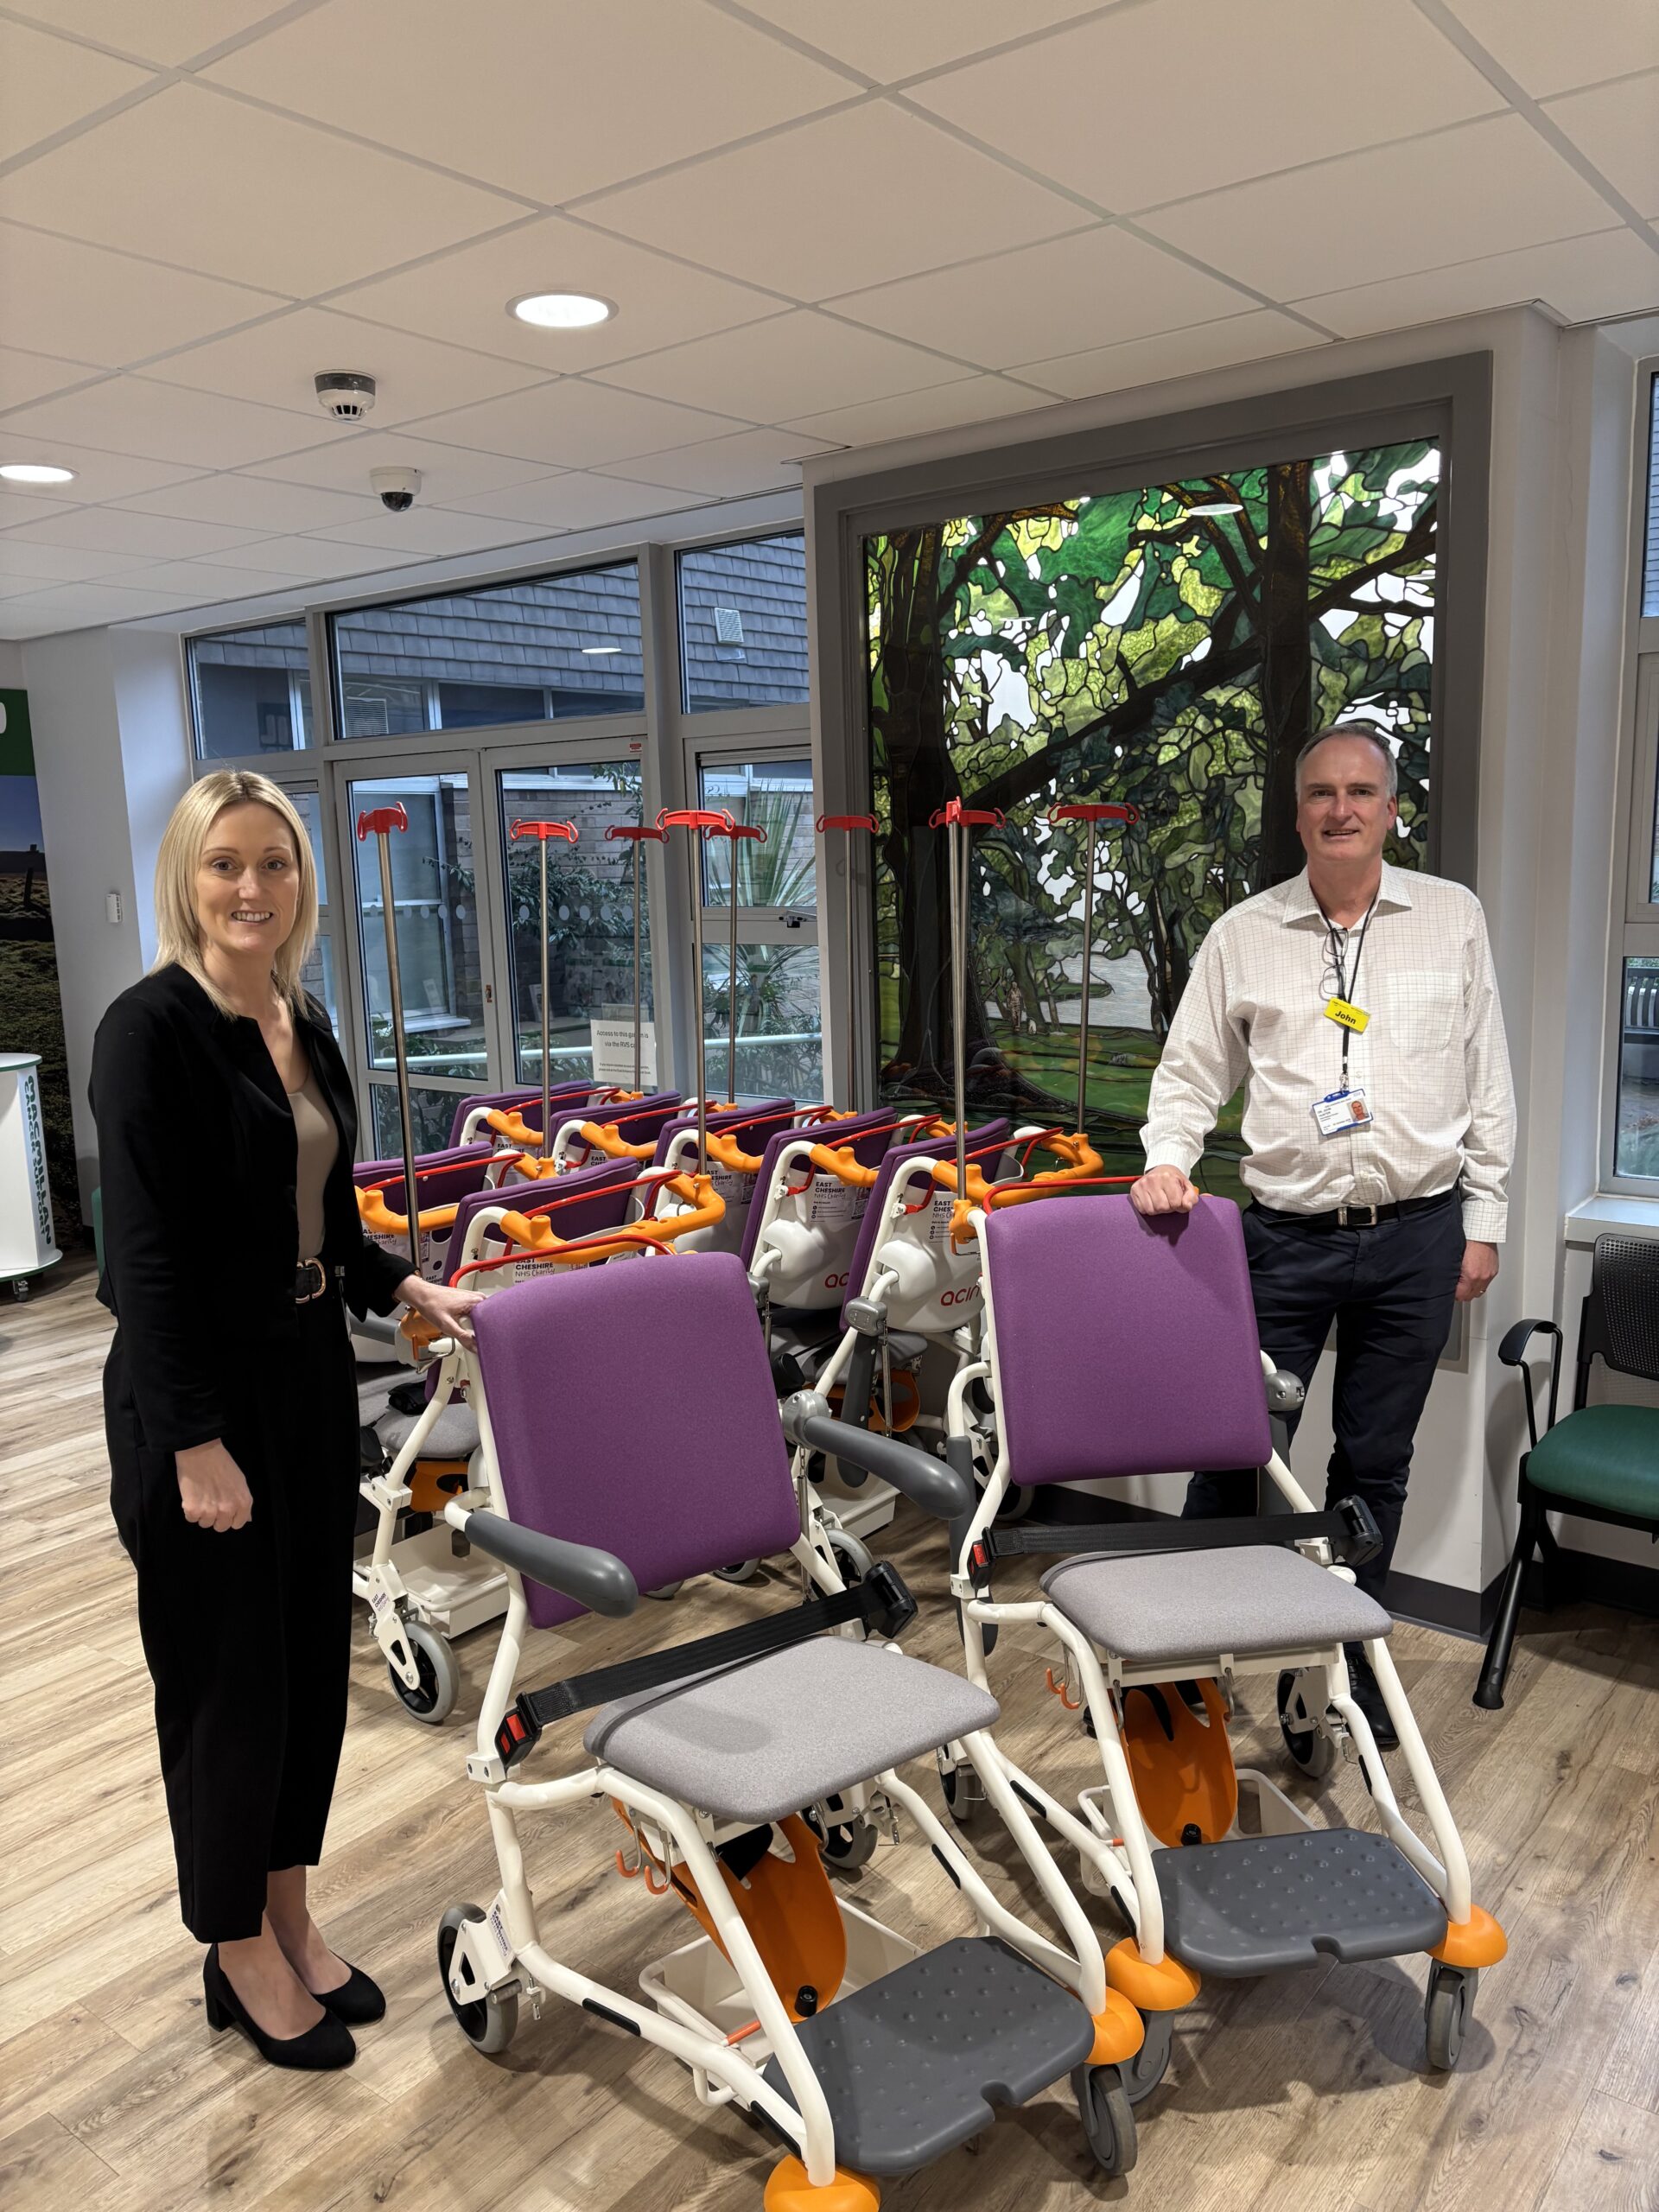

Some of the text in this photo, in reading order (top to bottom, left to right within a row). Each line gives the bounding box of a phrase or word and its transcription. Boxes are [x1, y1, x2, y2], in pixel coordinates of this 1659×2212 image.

[1335, 1011, 1357, 1025] John
[24, 1081, 46, 1236] CANCER SUPPORT
[29, 1075, 52, 1245] MACMILLAN
[532, 1268, 556, 1277] Charity
